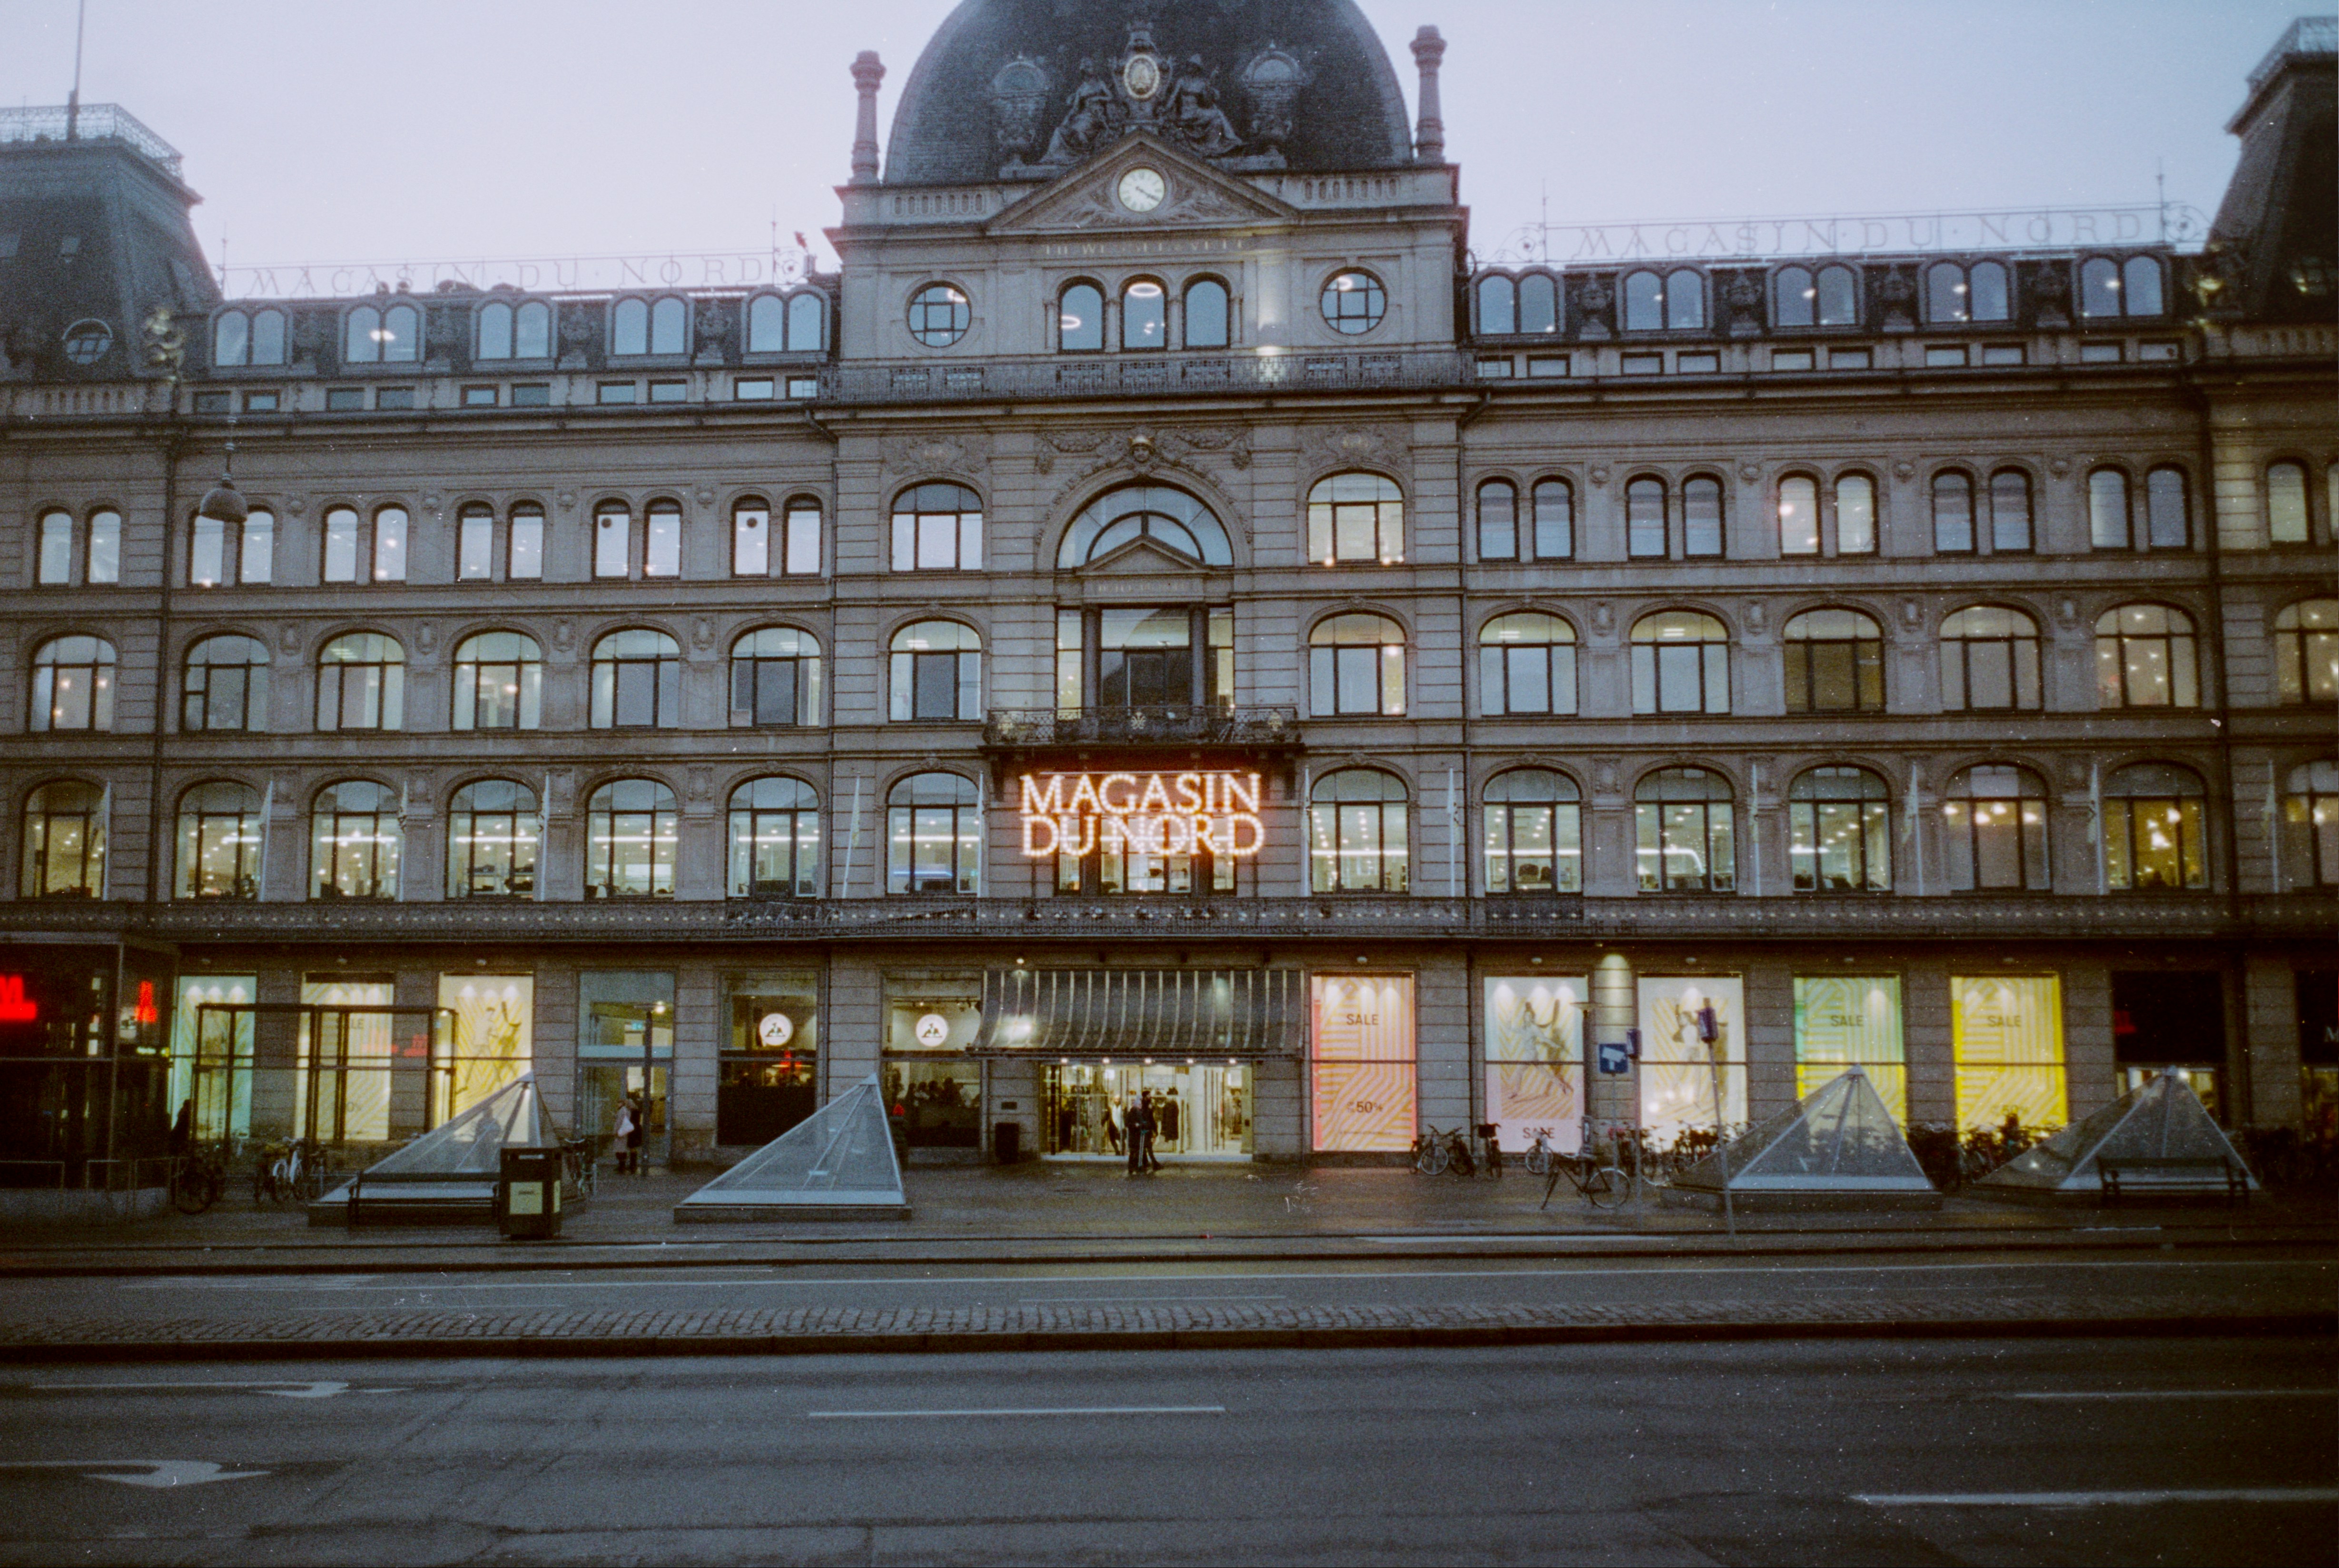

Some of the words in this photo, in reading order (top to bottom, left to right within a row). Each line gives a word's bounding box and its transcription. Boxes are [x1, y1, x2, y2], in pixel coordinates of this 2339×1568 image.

[1570, 220, 1838, 260] MAGASIN
[1858, 219, 1932, 250] DU
[1975, 212, 2141, 247] NORD
[244, 263, 484, 300] MAGASIN
[515, 261, 577, 291] DU
[618, 257, 762, 289] NORD
[1019, 773, 1262, 815] MAGASIN
[1020, 812, 1098, 858] DU
[1108, 812, 1265, 857] NORD
[1346, 1014, 1380, 1026] SALE
[1830, 1015, 1865, 1027] SALE
[1987, 1015, 2022, 1028] SALE
[1356, 1101, 1383, 1113] 50%
